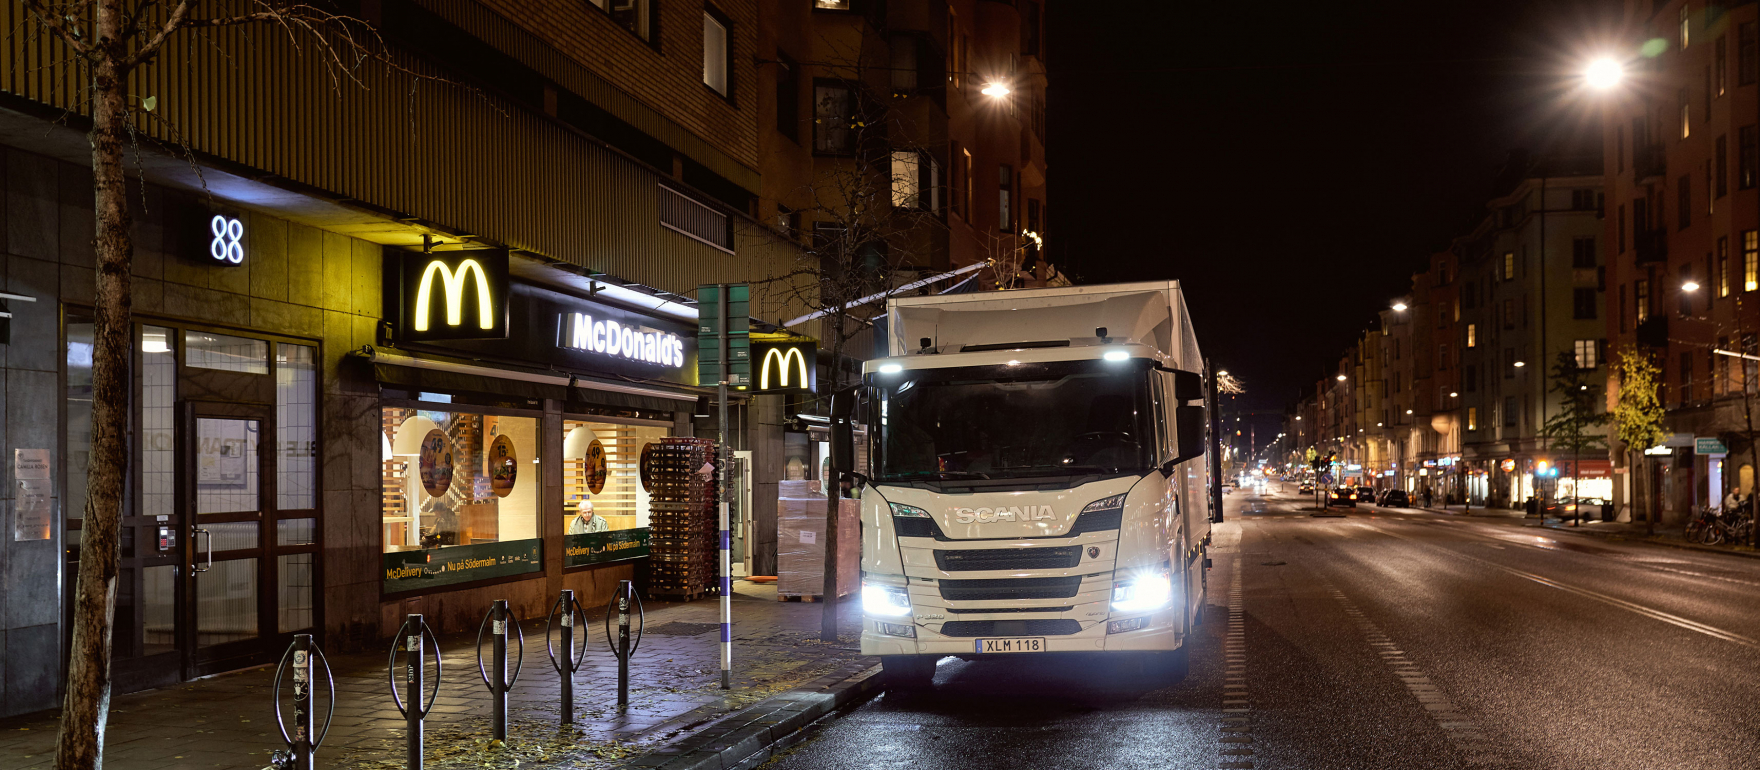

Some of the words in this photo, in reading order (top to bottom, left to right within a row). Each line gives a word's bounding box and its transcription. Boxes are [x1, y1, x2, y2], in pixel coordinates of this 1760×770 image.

[211, 214, 244, 264] 88
[572, 312, 684, 368] McDonald's
[956, 505, 1058, 524] SCANIA
[565, 545, 590, 557] McDelivery
[386, 566, 422, 579] McDelivery
[447, 561, 456, 571] Nu
[456, 558, 465, 572] på
[464, 556, 497, 570] Södermalm
[986, 640, 1012, 652] XLM
[1015, 639, 1040, 651] 118
